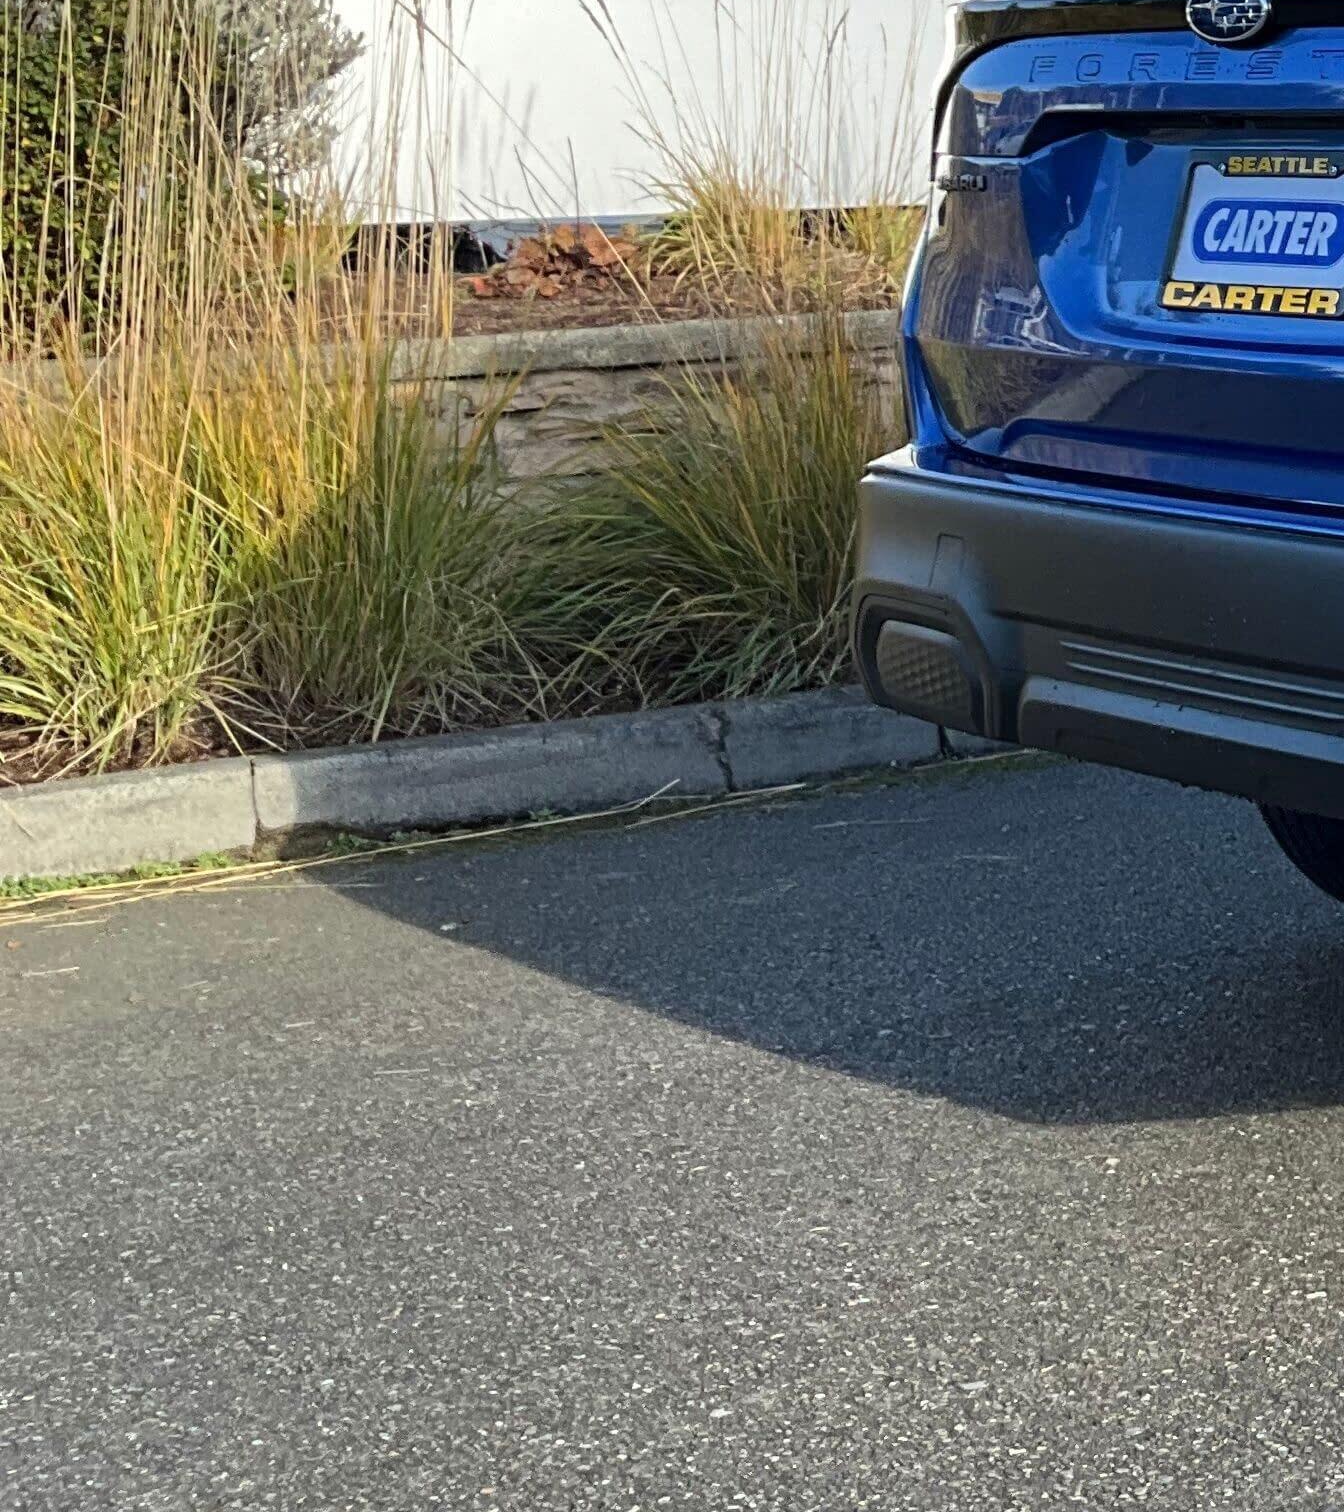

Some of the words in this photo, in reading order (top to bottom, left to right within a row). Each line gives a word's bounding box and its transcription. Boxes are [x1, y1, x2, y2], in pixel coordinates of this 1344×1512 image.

[1228, 156, 1329, 175] SEATTLE
[1203, 207, 1338, 257] CARTER
[1162, 281, 1340, 315] CARTER
